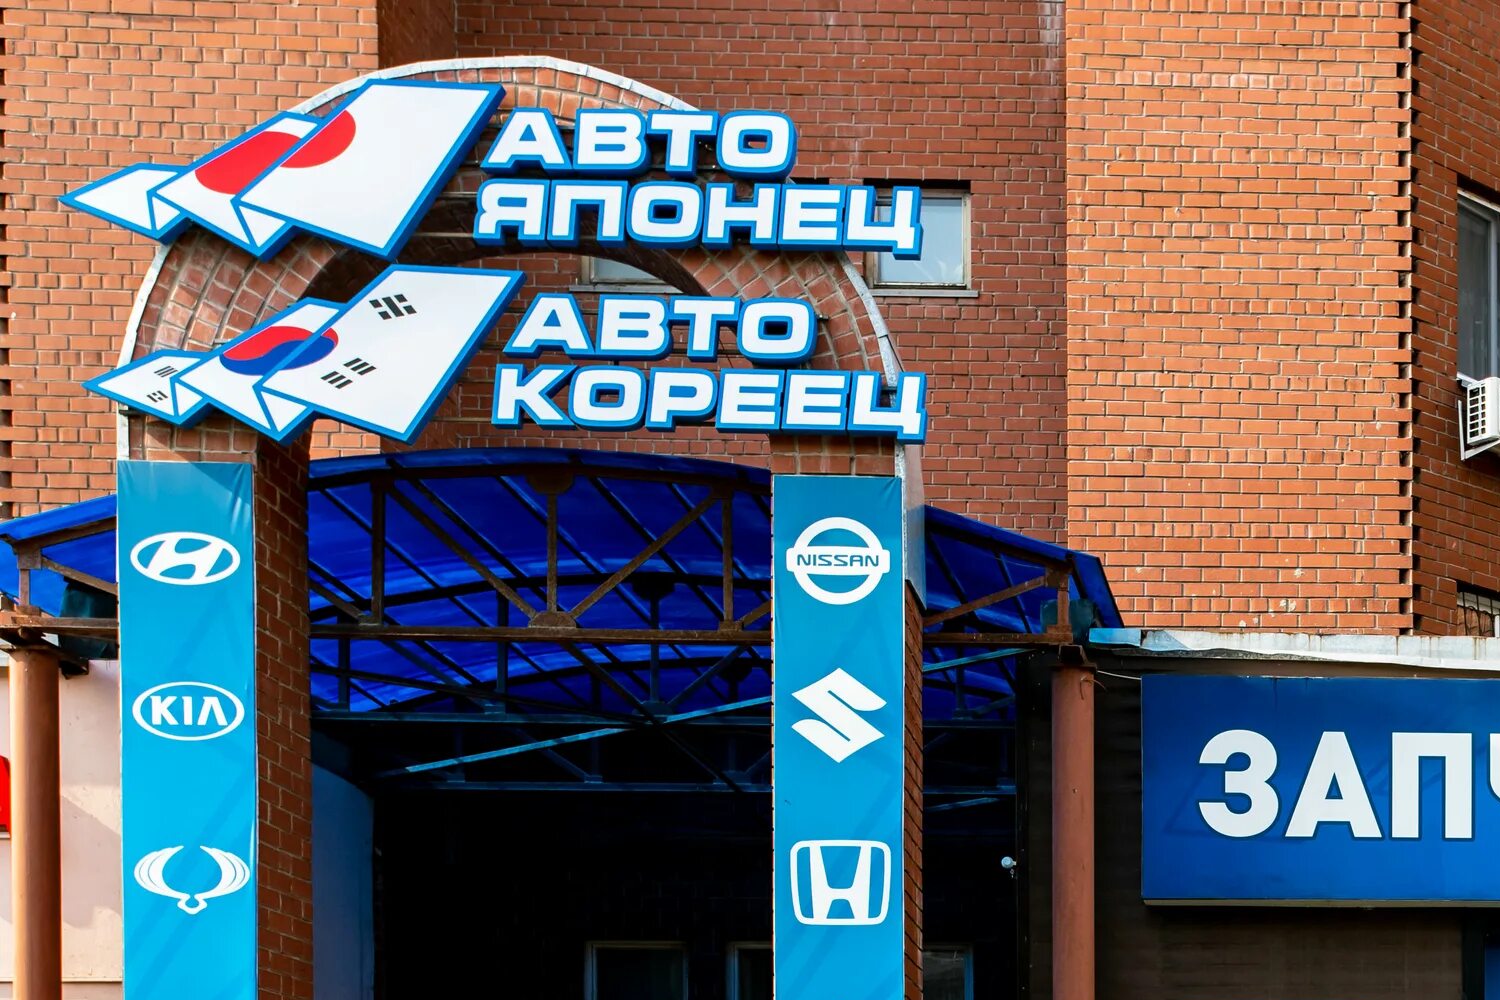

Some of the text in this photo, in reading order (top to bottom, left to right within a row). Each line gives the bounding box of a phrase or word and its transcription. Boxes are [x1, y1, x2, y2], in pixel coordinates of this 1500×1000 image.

[483, 109, 796, 177] АВТО
[476, 181, 921, 256] ЯПОНЕЦ
[507, 295, 815, 361] АВТО
[494, 365, 924, 442] КОРЕЕЦ
[797, 554, 879, 567] NISSAN
[150, 695, 229, 726] KIA
